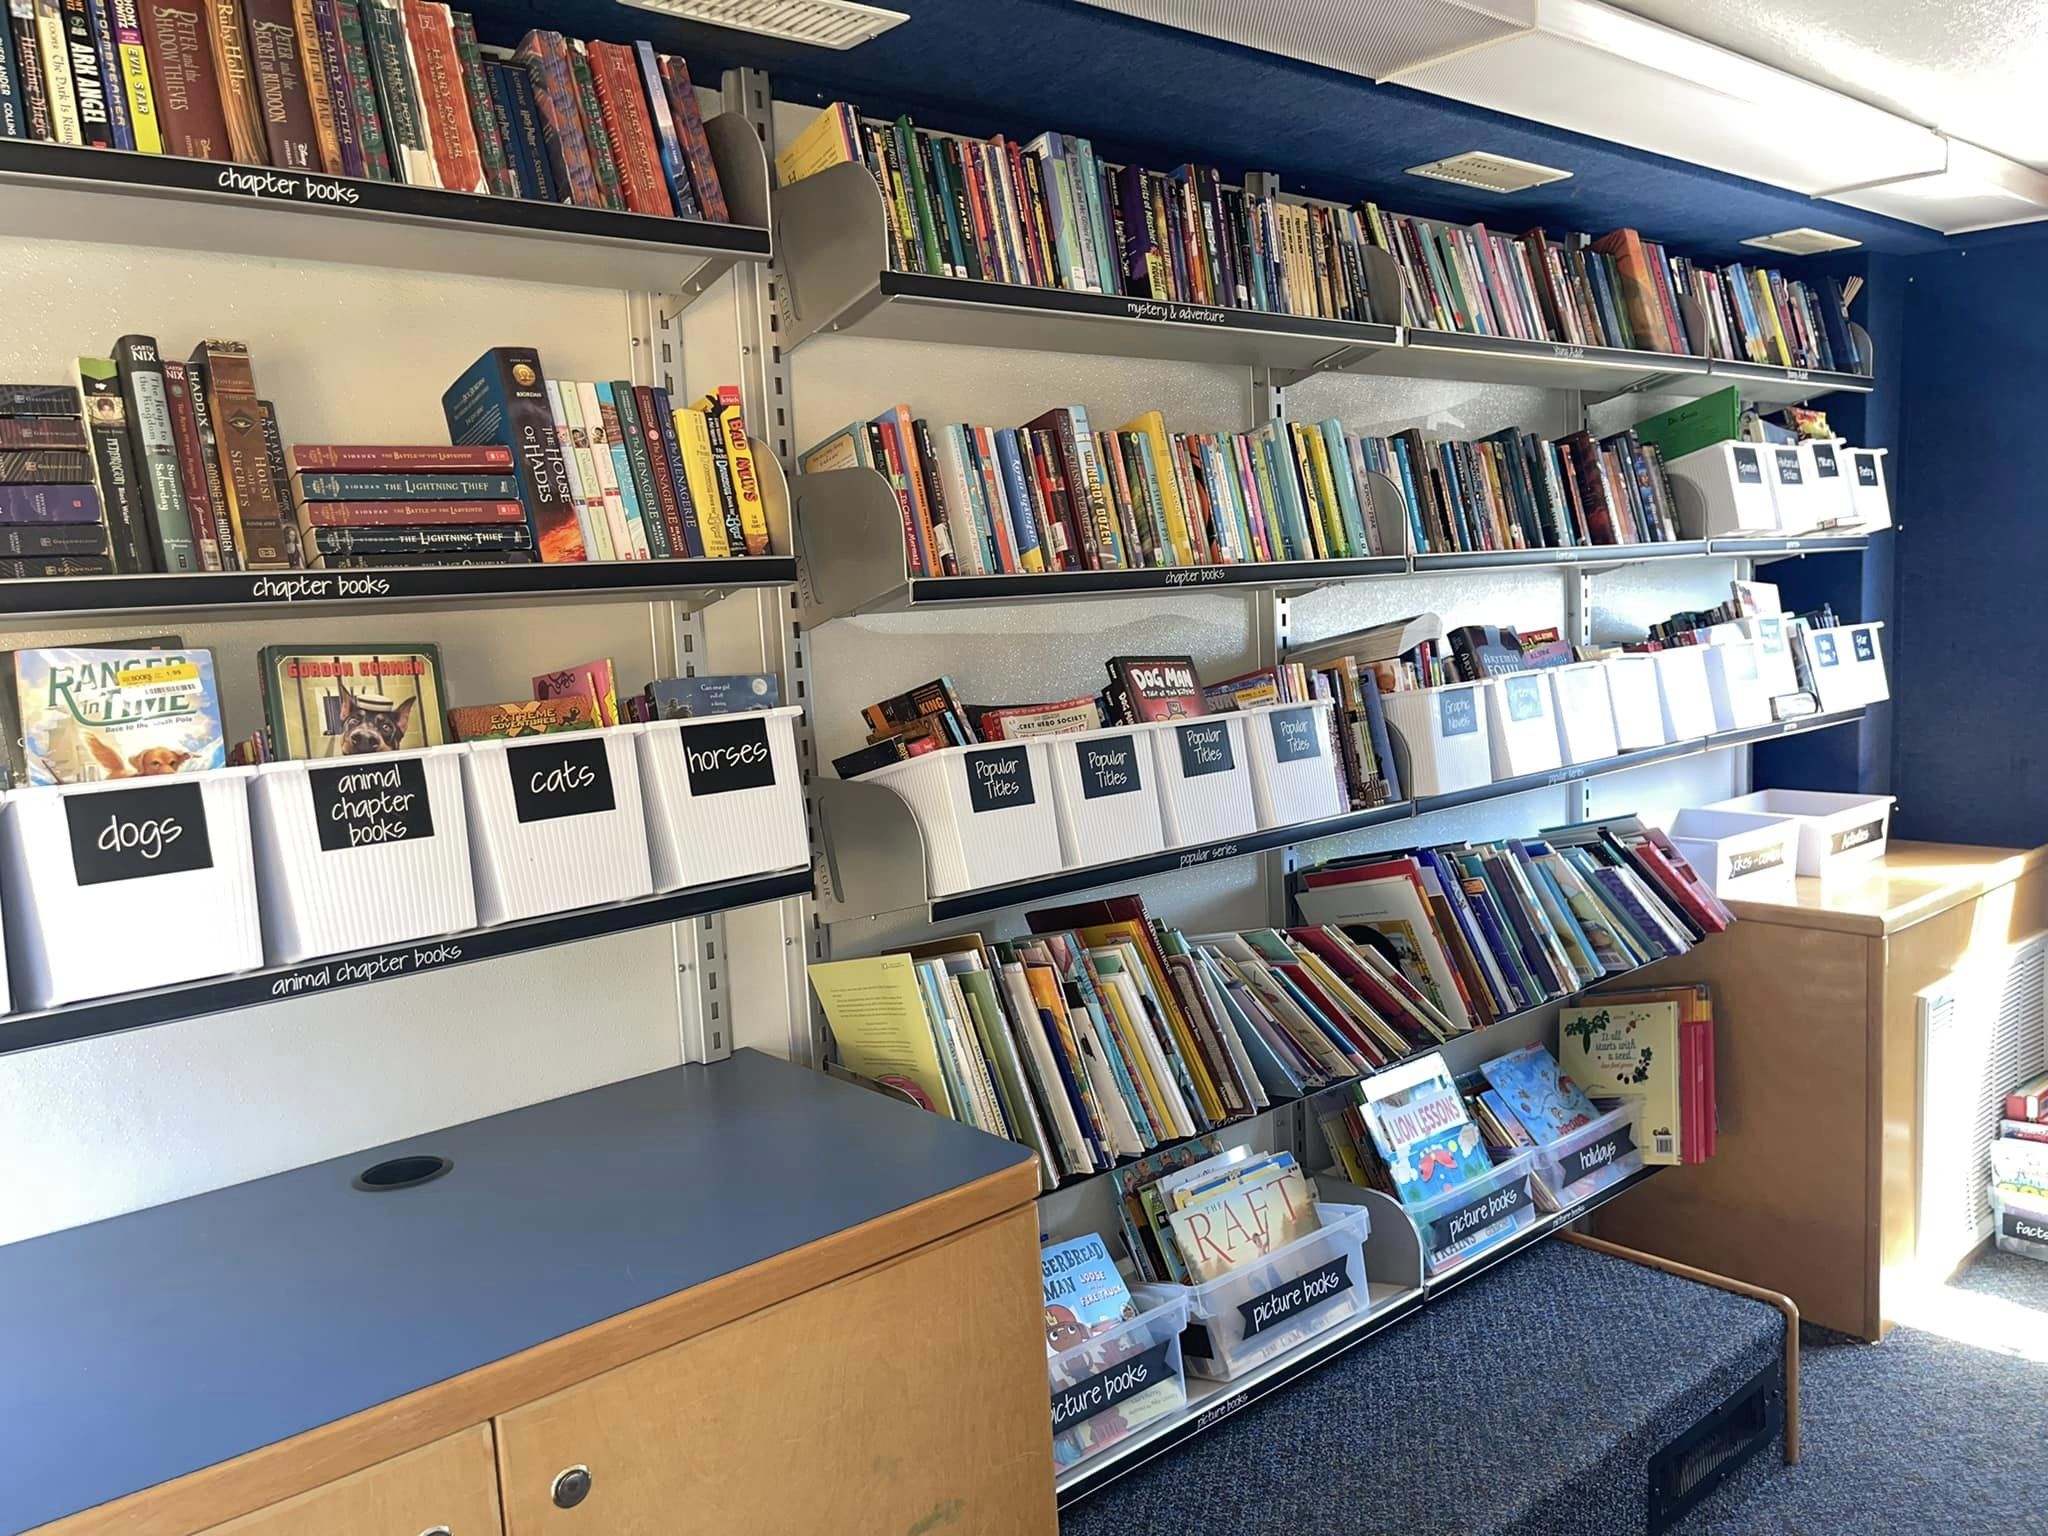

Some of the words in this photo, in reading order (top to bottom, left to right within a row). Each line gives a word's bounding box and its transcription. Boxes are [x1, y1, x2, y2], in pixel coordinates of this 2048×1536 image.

[114, 0, 129, 29] OWITZ
[123, 0, 138, 28] HONY
[172, 8, 200, 52] PETER
[217, 4, 238, 41] Ruby
[153, 5, 180, 64] SHADOW
[252, 18, 276, 62] SECRET
[273, 22, 295, 60] PETER
[70, 42, 99, 76] ARK
[223, 46, 246, 96] Holler
[56, 76, 69, 102] Dark
[127, 47, 141, 76] EVIL
[134, 82, 149, 115] STAR
[163, 63, 189, 111] THIEVES
[263, 72, 288, 124] RUNDOON
[324, 31, 343, 87] HARRY
[334, 89, 354, 145] POTTER
[76, 76, 108, 124] ANGEL
[431, 48, 451, 99] HARRY
[443, 104, 464, 159] POTTER
[4, 102, 16, 135] COLLINS
[218, 168, 300, 199] chapter
[305, 180, 360, 204] books
[958, 195, 972, 240] FRAMED
[1128, 303, 1167, 321] mystery
[1170, 305, 1177, 319] &
[1179, 308, 1225, 323] adventure
[132, 350, 157, 362] NIX
[166, 370, 185, 381] NIX
[189, 371, 208, 427] HADDIX
[524, 425, 536, 445] OF
[542, 427, 555, 447] THE
[727, 417, 747, 451] BAD
[154, 463, 169, 512] Saturday
[166, 463, 181, 511] Superior
[206, 463, 221, 499] AMONG
[231, 450, 249, 508] SECRETS
[254, 456, 272, 502] HOUSE
[384, 482, 402, 492] THE
[405, 479, 458, 494] LIGHTNING
[460, 480, 490, 493] THIEF
[524, 444, 553, 503] HADES
[546, 447, 570, 503] HOUSE
[633, 447, 659, 520] MENAGERIE
[653, 452, 678, 524] MENAGERIE
[671, 453, 698, 528] MENAGERIE
[736, 456, 759, 504] NEWS
[1068, 455, 1082, 494] CHASING
[1088, 468, 1104, 505] NERDY
[214, 499, 226, 517] THE
[1020, 493, 1037, 544] Nightingale
[217, 517, 233, 552] HIDDEN
[399, 535, 417, 543] THE
[419, 531, 474, 546] LIGHTNING
[474, 531, 505, 544] THIEF
[1095, 507, 1112, 546] DOZEN
[909, 534, 921, 567] Mermaid
[253, 576, 333, 602] chapter
[338, 575, 390, 597] books
[1165, 571, 1199, 587] chapter
[1201, 569, 1225, 582] books
[287, 661, 354, 678] GORDON
[359, 661, 425, 676] KORMAN
[1130, 667, 1165, 689] DOG
[1164, 667, 1195, 689] MAN
[83, 700, 99, 715] in
[175, 716, 193, 724] Pole
[491, 706, 558, 726] EXTREME
[918, 696, 946, 713] KING
[490, 717, 558, 732] ADVENTURES
[1018, 722, 1036, 731] CRET
[1057, 713, 1089, 725] SOCIETY
[1186, 728, 1222, 748] Popular
[1280, 718, 1309, 736] Popular
[687, 741, 769, 774] horses
[1087, 750, 1128, 770] Popular
[1193, 745, 1223, 764] Titles
[1286, 736, 1311, 753] Titles
[338, 763, 402, 795] animal
[530, 760, 596, 795] cats
[976, 759, 1020, 780] Popular
[1095, 771, 1128, 789] Titles
[983, 779, 1020, 800] Titles
[331, 791, 416, 825] chapter
[98, 814, 183, 859] dogs
[349, 818, 408, 847] books
[1180, 847, 1211, 867] popular
[1212, 842, 1238, 857] series
[272, 965, 331, 997] animal
[336, 953, 409, 989] chapter
[414, 942, 463, 968] books
[1596, 1042, 1617, 1051] starts
[1618, 1039, 1637, 1050] with
[1611, 1030, 1622, 1041] all
[1388, 1114, 1416, 1145] LION
[1416, 1095, 1462, 1134] LESSONS
[1580, 1141, 1617, 1170] holidays
[1184, 1174, 1299, 1265] RAFT
[1204, 1201, 1225, 1215] THE
[1449, 1204, 1488, 1242] picture
[1488, 1189, 1518, 1217] books
[1042, 1241, 1105, 1278] GERBREAD
[1043, 1276, 1078, 1301] MAN
[1079, 1270, 1106, 1284] LOOSE
[1253, 1288, 1302, 1332] picture
[1304, 1271, 1340, 1303] books
[1051, 1383, 1102, 1424] icture
[1104, 1364, 1147, 1400] books
[1197, 1404, 1227, 1431] picture
[1227, 1392, 1250, 1412] books
